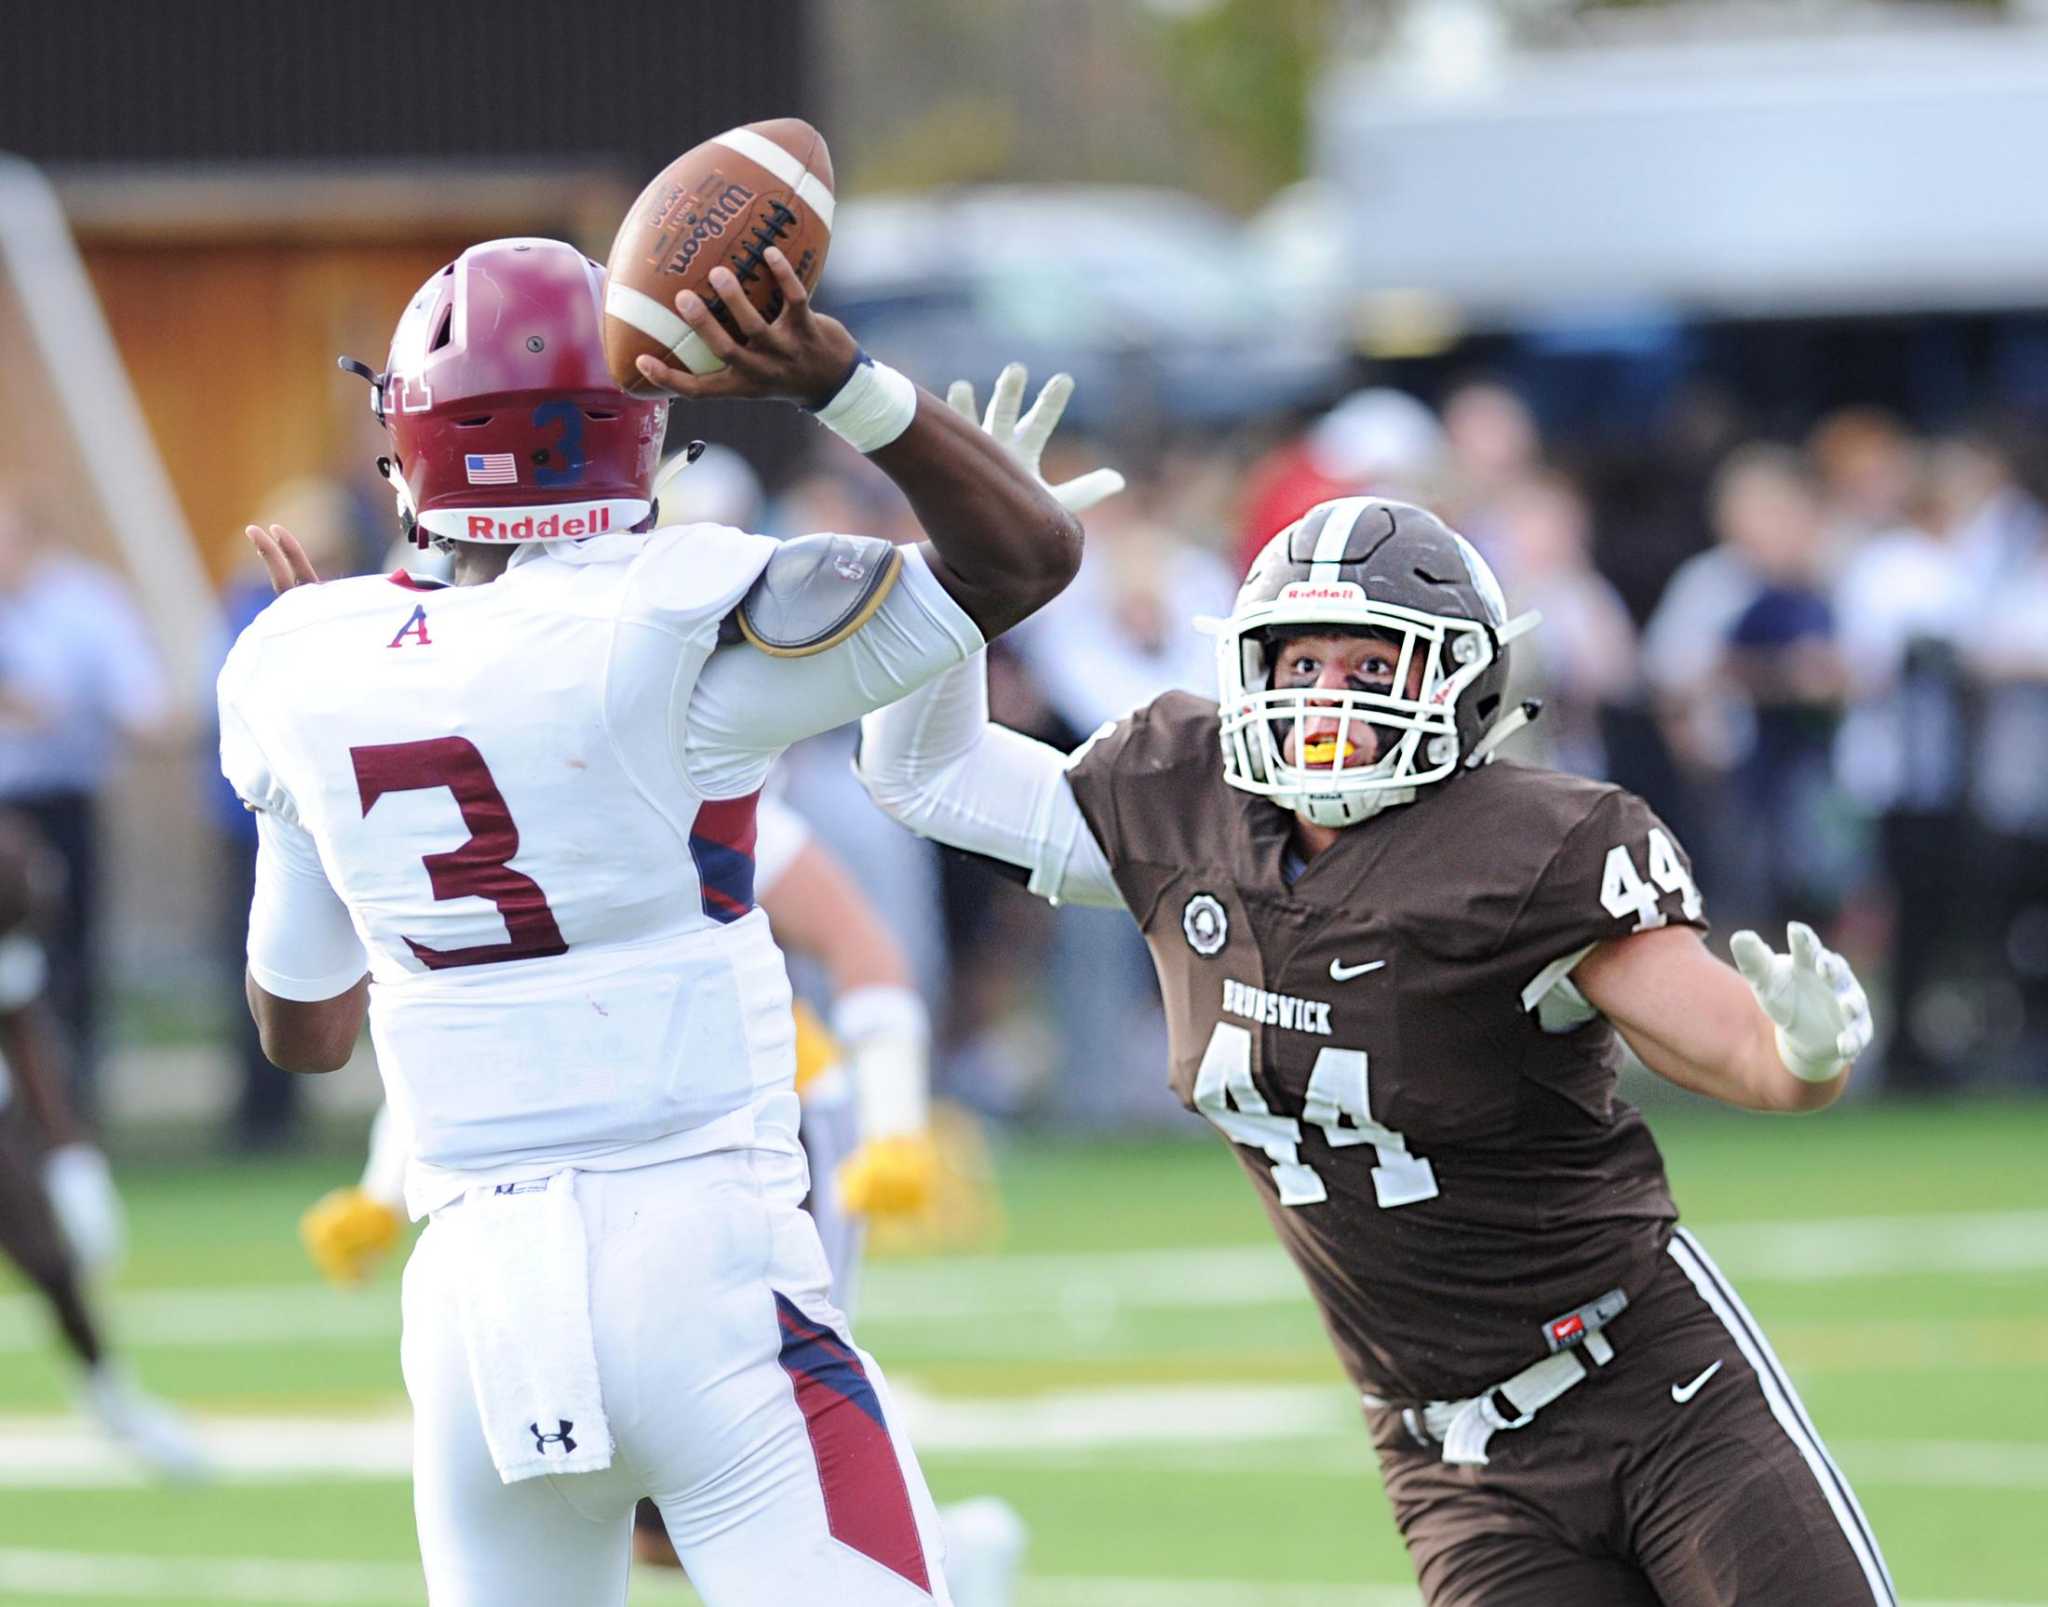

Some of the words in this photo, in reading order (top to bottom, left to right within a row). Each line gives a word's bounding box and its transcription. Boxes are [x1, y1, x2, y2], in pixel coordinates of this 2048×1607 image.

[667, 184, 756, 275] Wilson
[532, 401, 585, 489] 3
[467, 507, 611, 540] Riddell
[387, 604, 432, 649] A
[1288, 588, 1353, 600] Riddell
[349, 735, 569, 970] 3
[1600, 827, 1702, 933] 44
[1222, 978, 1333, 1036] BRUNSWICK
[1193, 1020, 1440, 1208] 44
